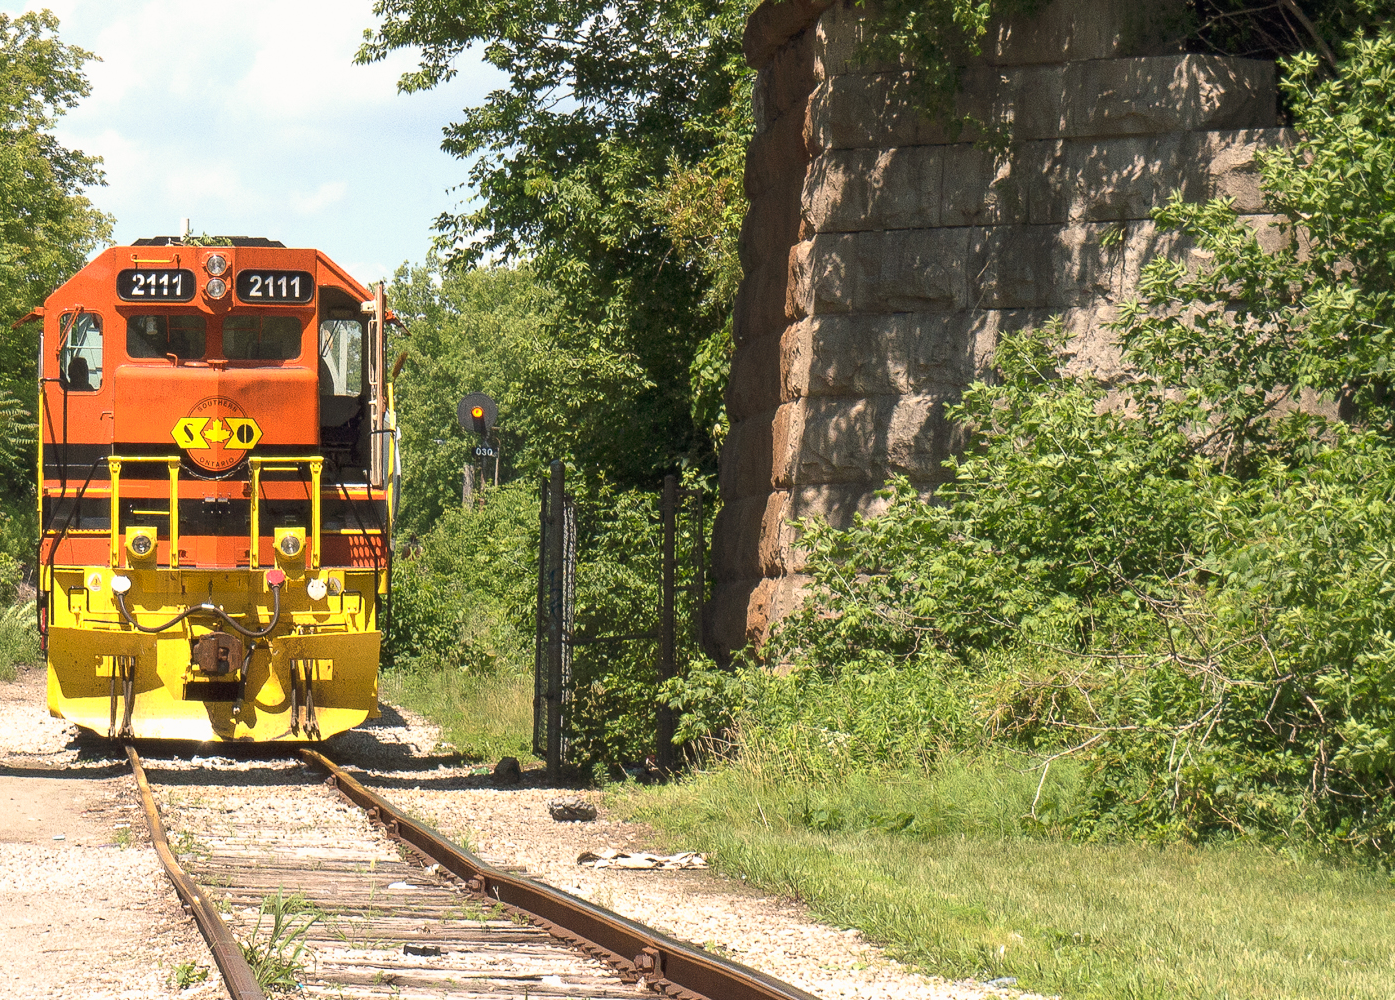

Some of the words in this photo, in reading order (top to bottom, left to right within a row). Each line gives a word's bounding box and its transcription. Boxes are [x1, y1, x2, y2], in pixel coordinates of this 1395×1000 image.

[131, 273, 182, 296] 2111
[249, 275, 300, 298] 2111
[197, 399, 238, 413] SOUTHERN
[183, 423, 194, 443] S
[199, 457, 235, 468] ONTARIO
